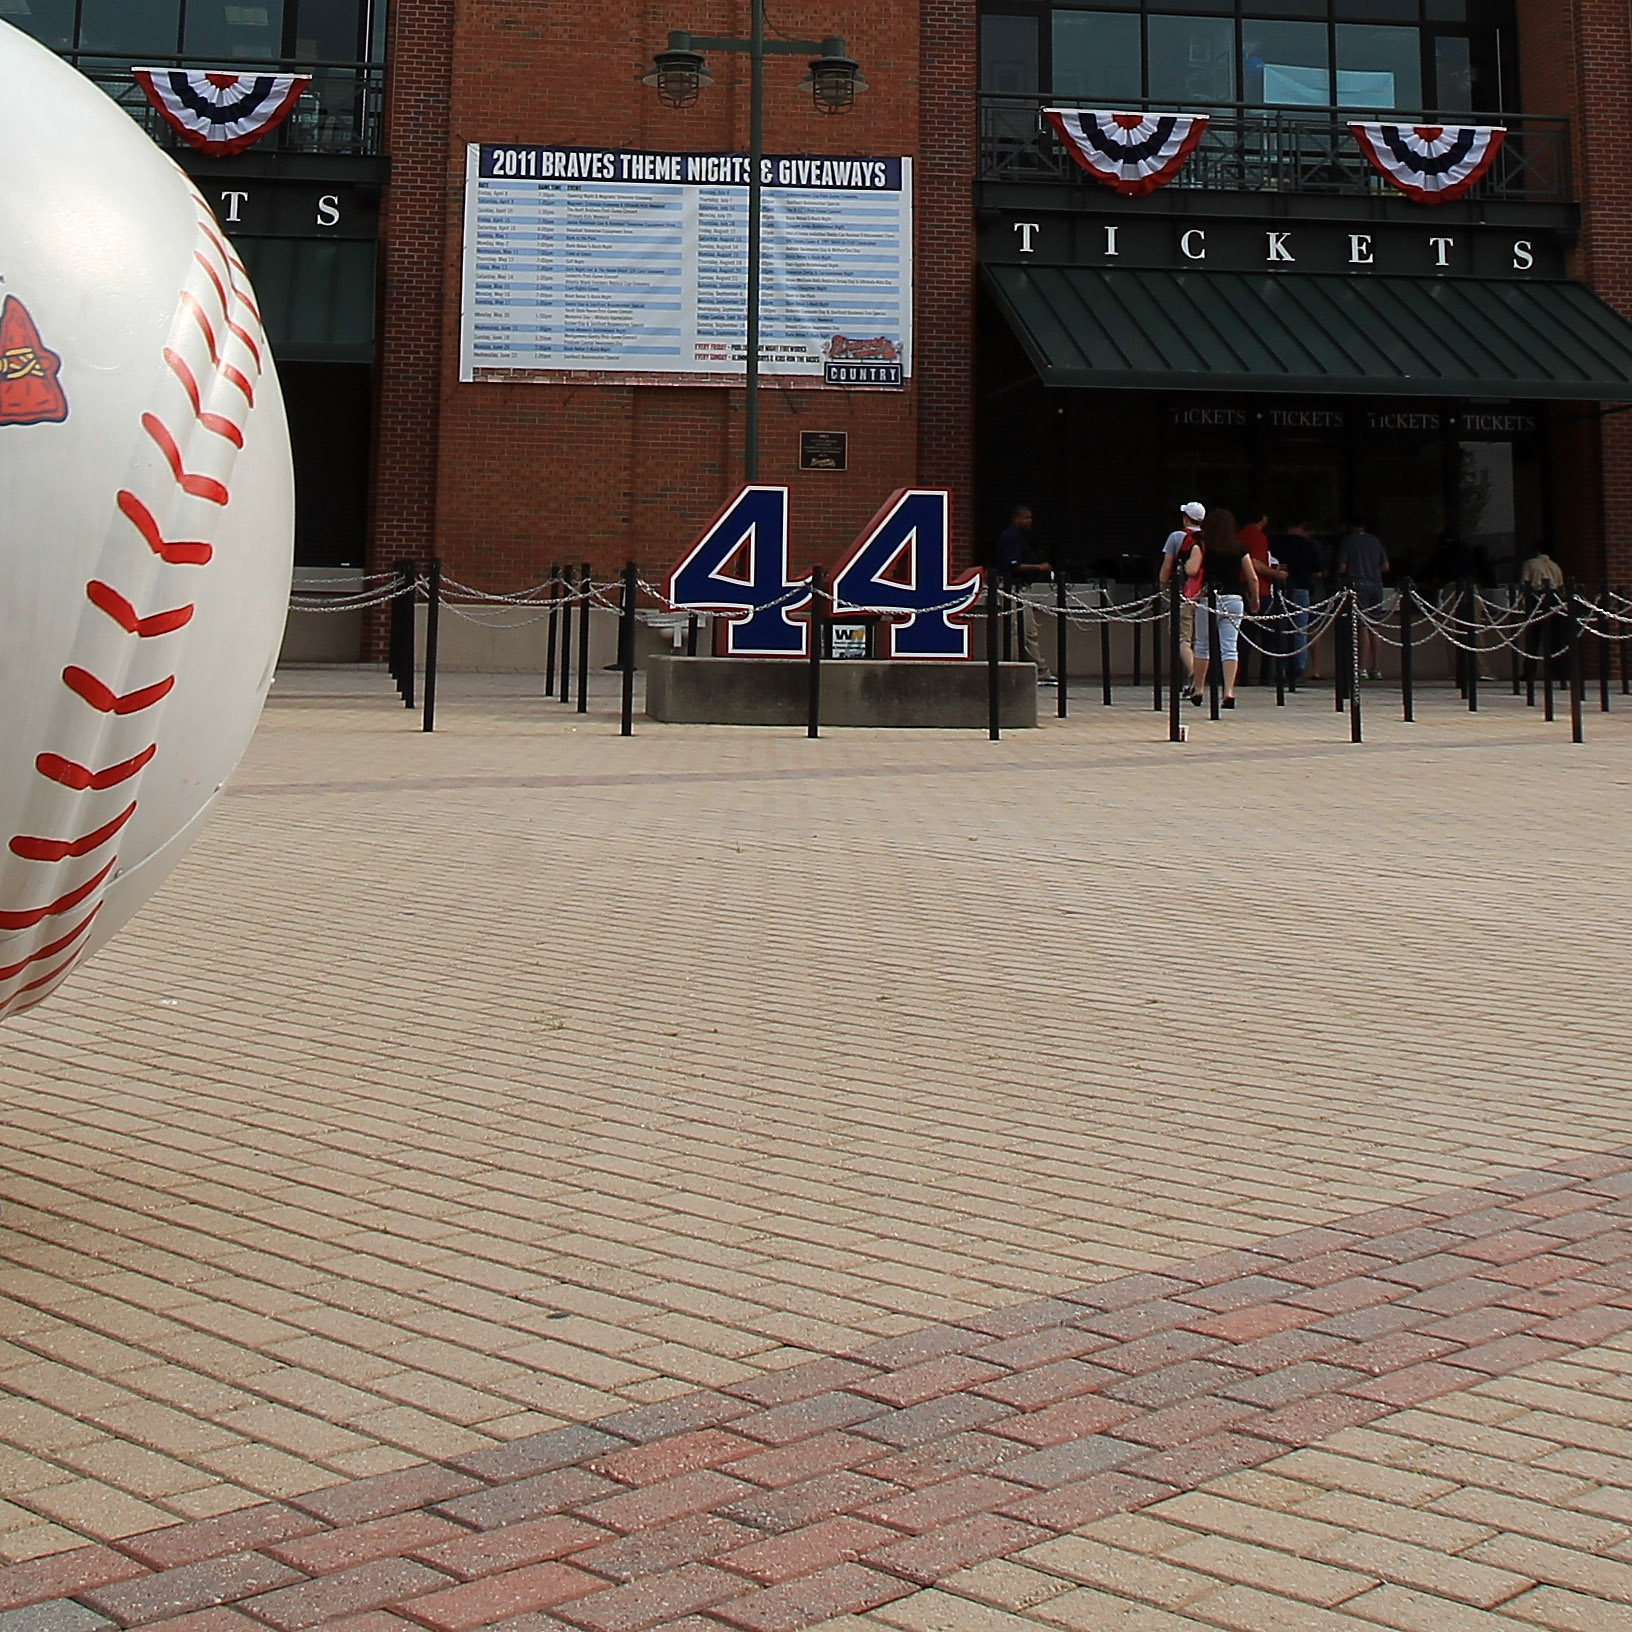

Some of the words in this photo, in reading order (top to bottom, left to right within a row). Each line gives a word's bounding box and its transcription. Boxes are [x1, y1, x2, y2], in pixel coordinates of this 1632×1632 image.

[492, 149, 537, 177] 2011
[541, 151, 615, 179] BRAVES
[620, 154, 681, 181] THEME
[688, 156, 750, 183] NIGHTS
[760, 159, 773, 184] &
[779, 159, 886, 188] GIVEAWAYS
[1013, 222, 1536, 270] TICKETS
[830, 367, 897, 381] COUNTRY
[1269, 409, 1344, 428] TICKETS
[1462, 413, 1536, 432] TICKETS
[667, 482, 984, 661] 44
